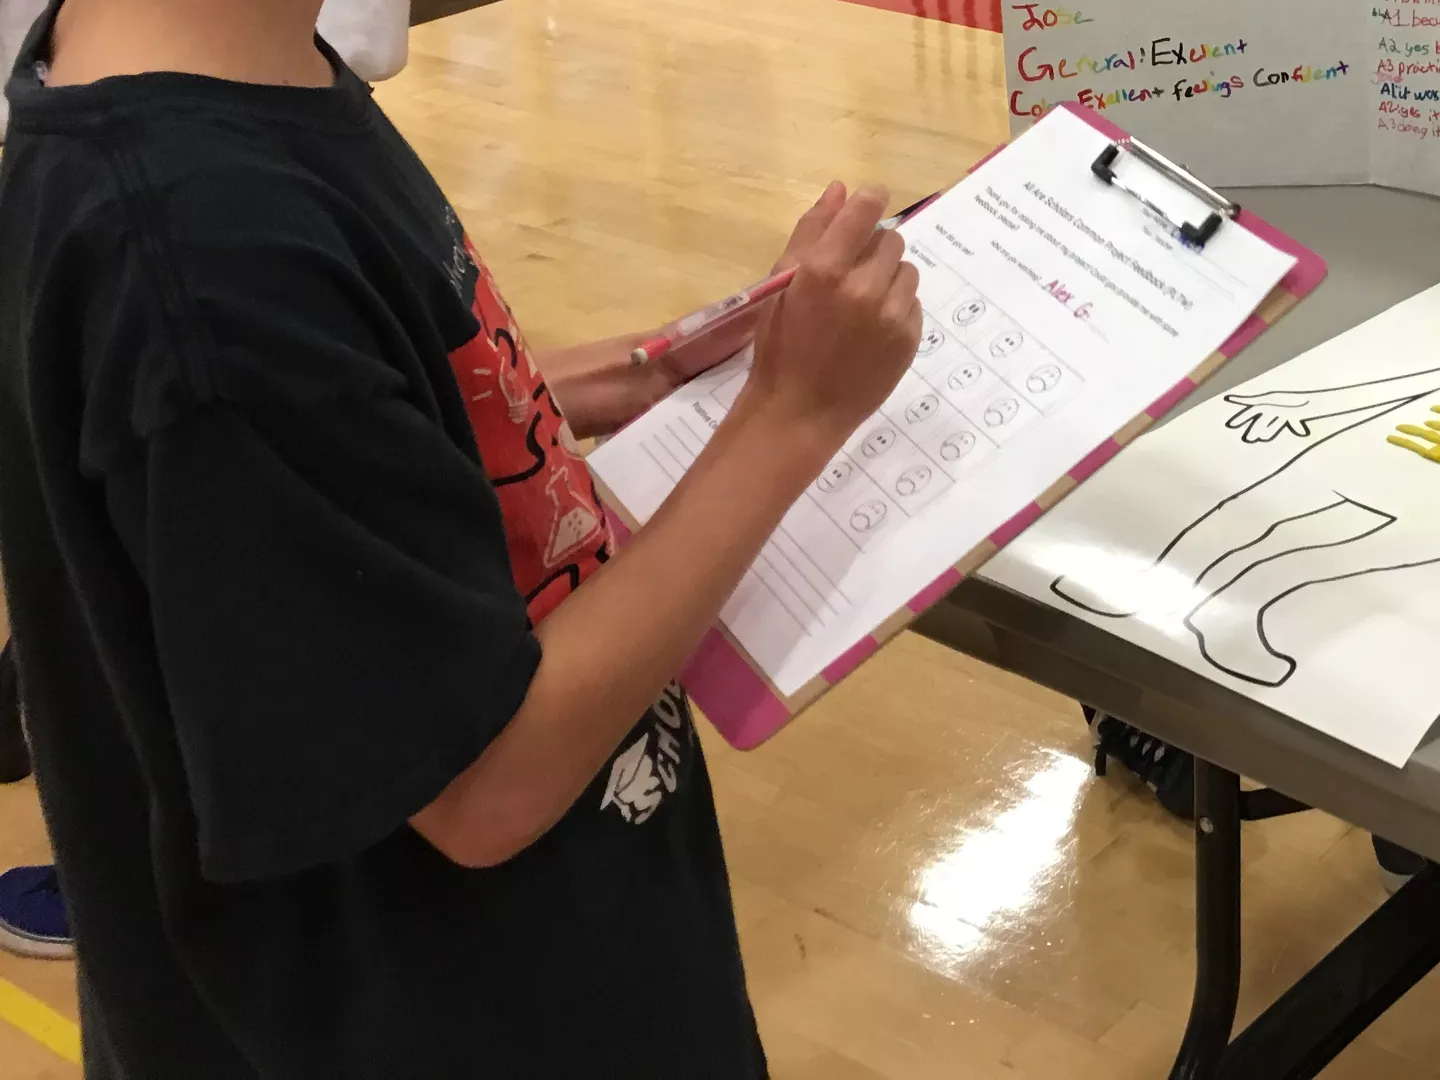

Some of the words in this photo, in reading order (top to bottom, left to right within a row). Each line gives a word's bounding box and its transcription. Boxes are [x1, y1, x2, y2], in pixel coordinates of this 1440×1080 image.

[1012, 3, 1095, 31] Jose
[1405, 42, 1429, 58] yes
[1046, 279, 1075, 304] Alex
